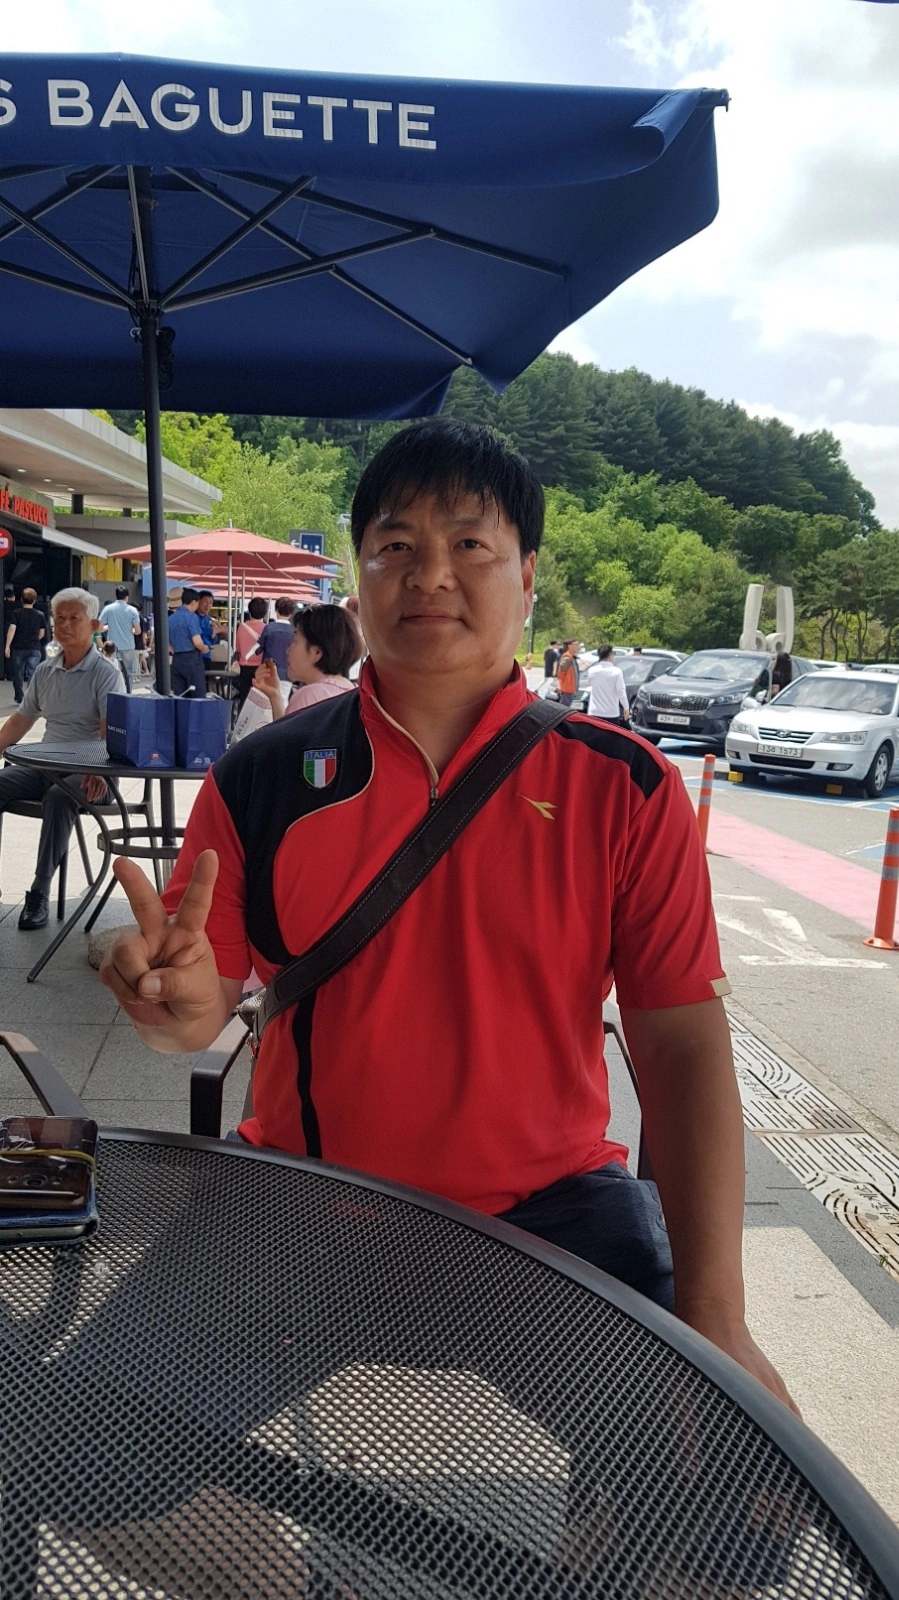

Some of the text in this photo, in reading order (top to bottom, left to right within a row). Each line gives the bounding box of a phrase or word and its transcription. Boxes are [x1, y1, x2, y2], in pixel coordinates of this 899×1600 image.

[47, 78, 438, 150] BAGUETTE
[306, 750, 334, 760] ITALIA
[779, 747, 798, 756] 1573
